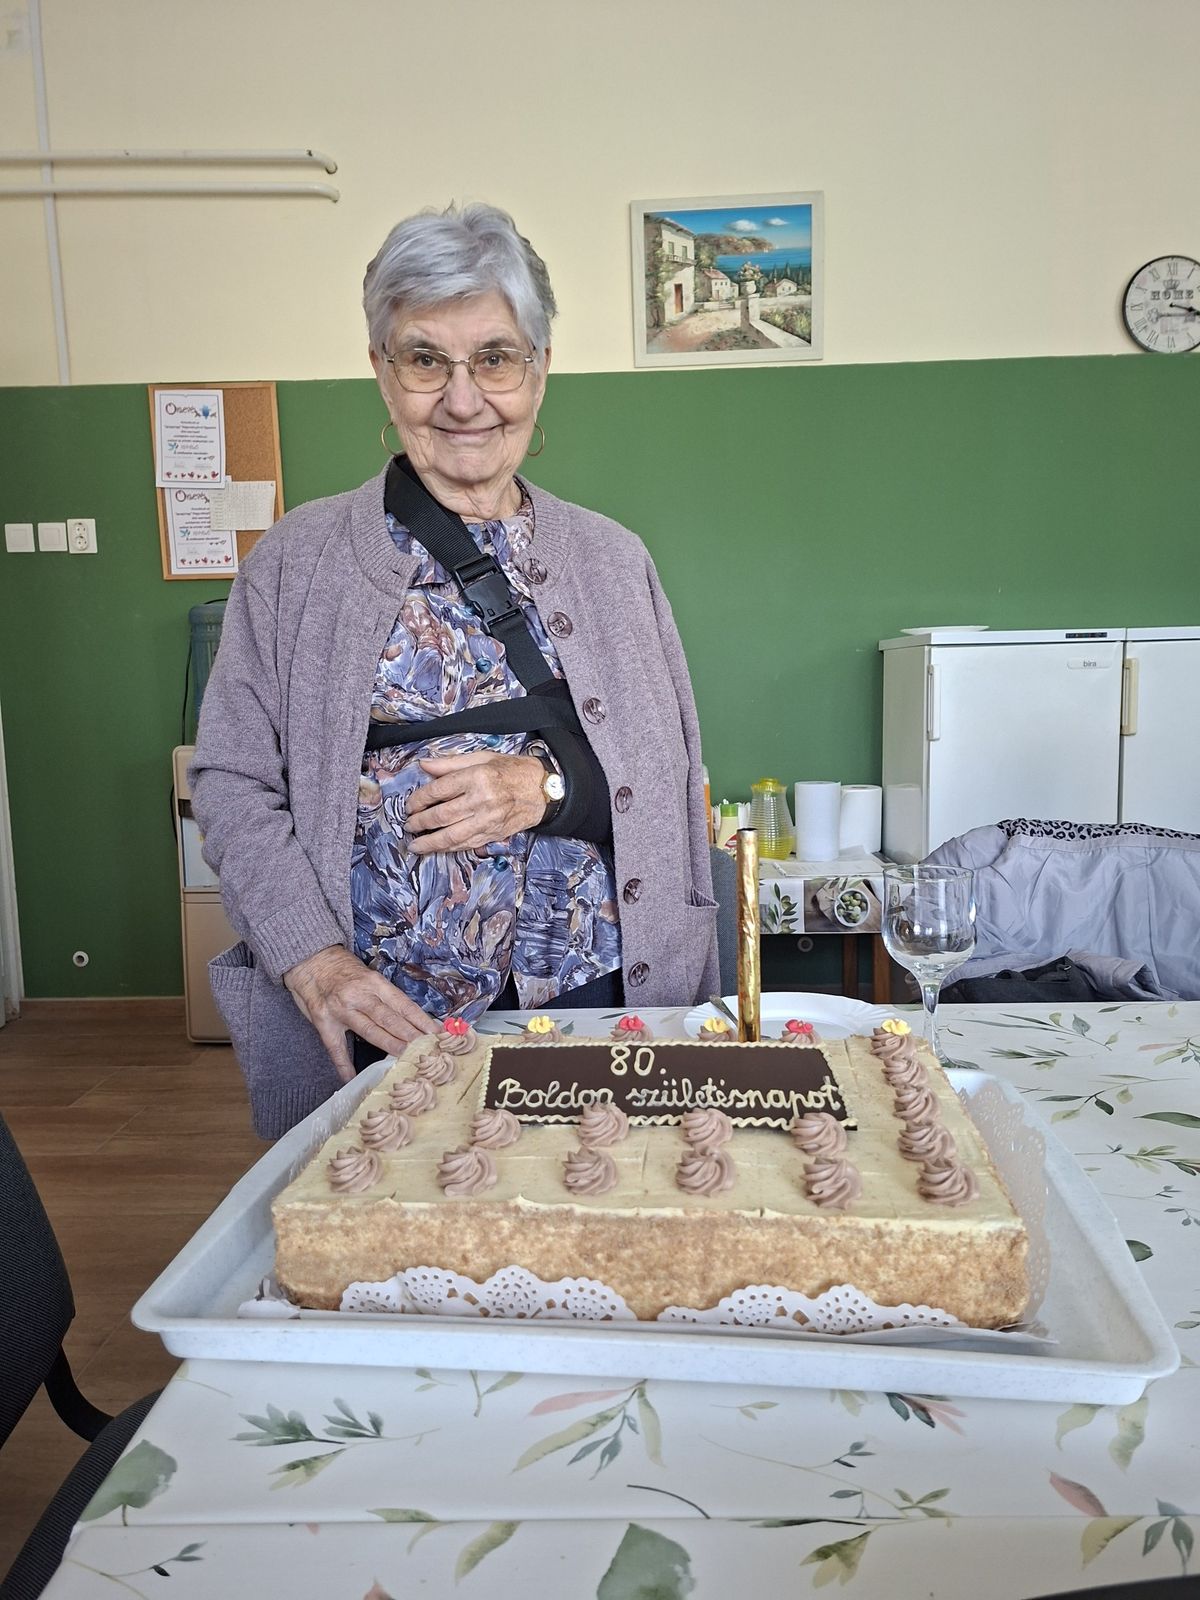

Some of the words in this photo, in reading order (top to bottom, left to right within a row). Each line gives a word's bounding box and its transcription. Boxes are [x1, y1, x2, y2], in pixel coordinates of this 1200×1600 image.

[1150, 290, 1194, 300] HOME
[610, 1045, 667, 1076] 80.
[625, 1076, 842, 1119] születésnapot
